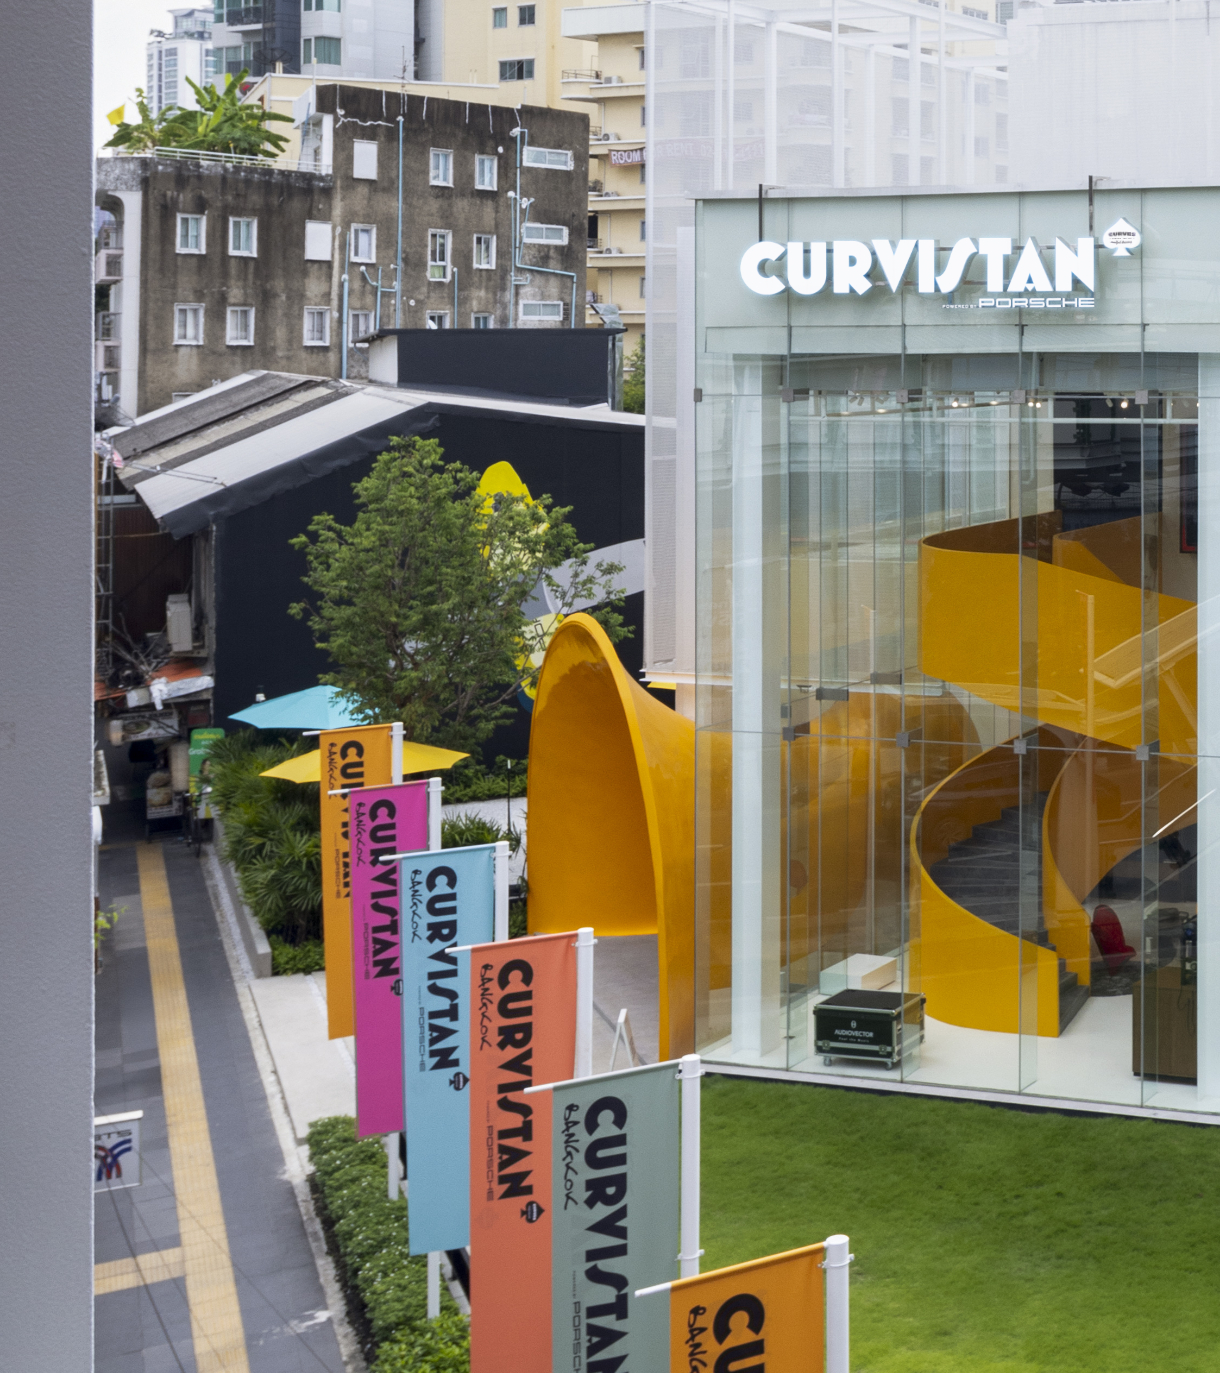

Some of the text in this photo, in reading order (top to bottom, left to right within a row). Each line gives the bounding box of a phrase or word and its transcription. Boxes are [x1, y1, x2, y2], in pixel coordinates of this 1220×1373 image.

[611, 149, 641, 164] ROOM
[740, 237, 1096, 295] CURVISTAN
[978, 297, 1095, 308] PORSCHE
[354, 802, 366, 867] BANGKOK
[369, 799, 399, 979] CURVISTAN
[409, 869, 423, 943] BANGKOK
[426, 865, 460, 1071] CURVISTAN
[478, 963, 494, 1051] BANGKOK
[834, 1029, 874, 1038] AUDIOVECTOR
[496, 958, 534, 1201] CURVISTAN
[486, 1125, 494, 1202] PORSCHE
[561, 1103, 580, 1210] BANGKOK
